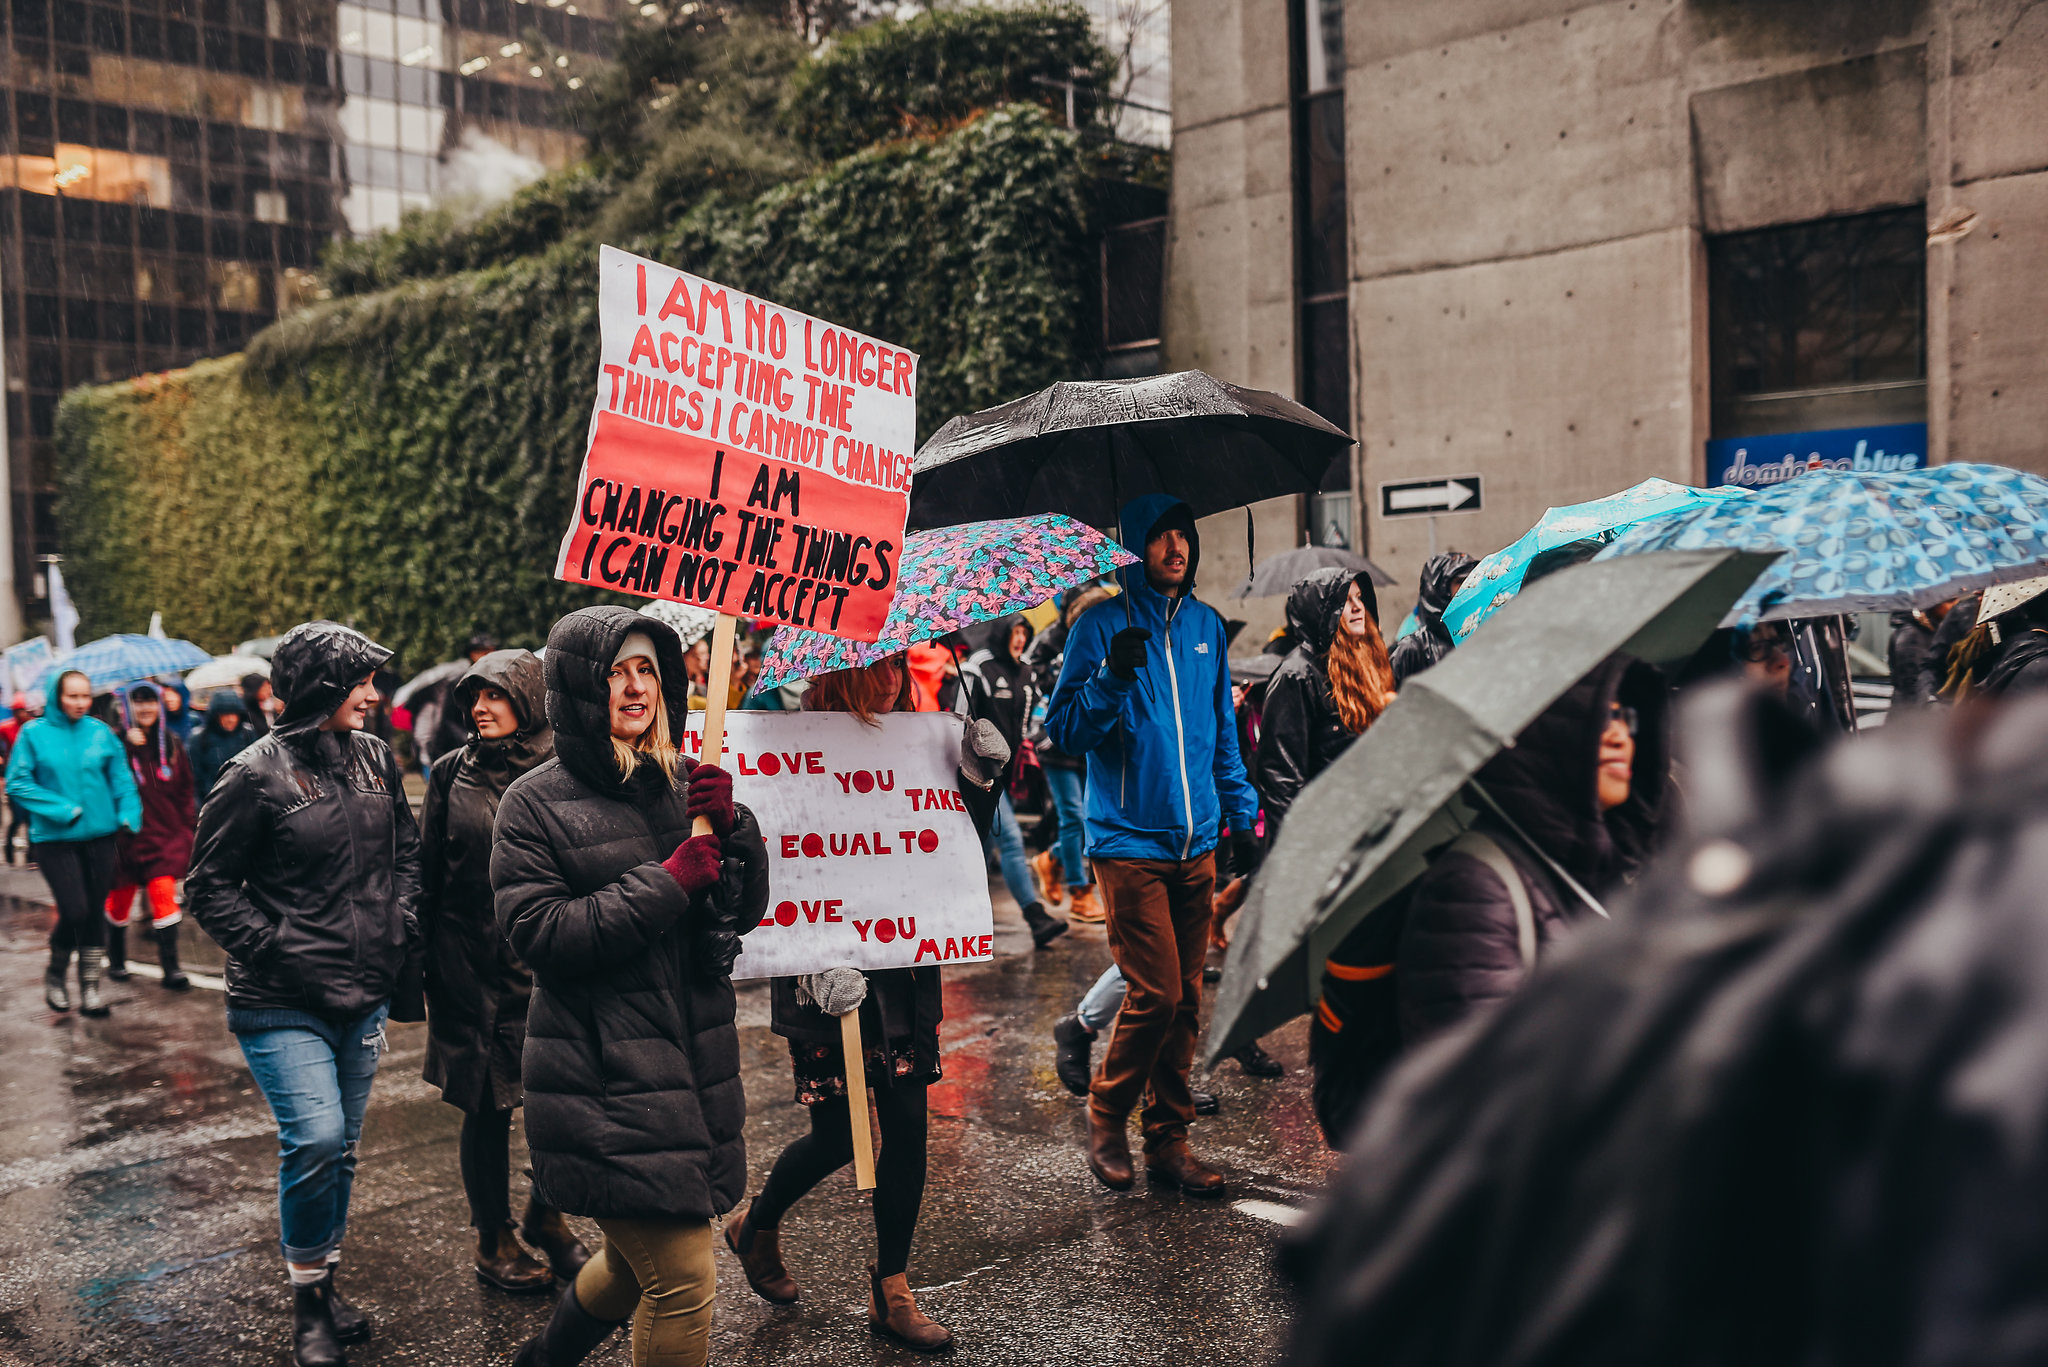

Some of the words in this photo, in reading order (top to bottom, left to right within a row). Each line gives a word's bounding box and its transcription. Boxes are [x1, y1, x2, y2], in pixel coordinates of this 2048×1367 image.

[629, 324, 793, 412] ACCEPTING
[803, 375, 856, 432] THE
[637, 264, 646, 316] I
[658, 277, 732, 344] AM
[745, 299, 786, 359] NO
[804, 319, 912, 397] LONGER
[604, 364, 703, 431] THINGS
[711, 398, 721, 438] I
[729, 402, 829, 468] CANNOT
[833, 436, 913, 491] CHANGE
[710, 451, 724, 500] I
[747, 464, 799, 517] AM
[581, 532, 601, 579] I
[742, 570, 849, 630] ACCEPT
[583, 478, 727, 552] CHANGING
[734, 508, 785, 569] THE
[792, 523, 893, 590] THINGS
[737, 752, 825, 776] LOVE
[834, 770, 894, 793] YOU
[905, 788, 966, 812] TAKE
[781, 832, 891, 858] EQUAL
[899, 829, 938, 853] TO
[852, 917, 916, 943] YOU
[914, 935, 992, 962] MAKE
